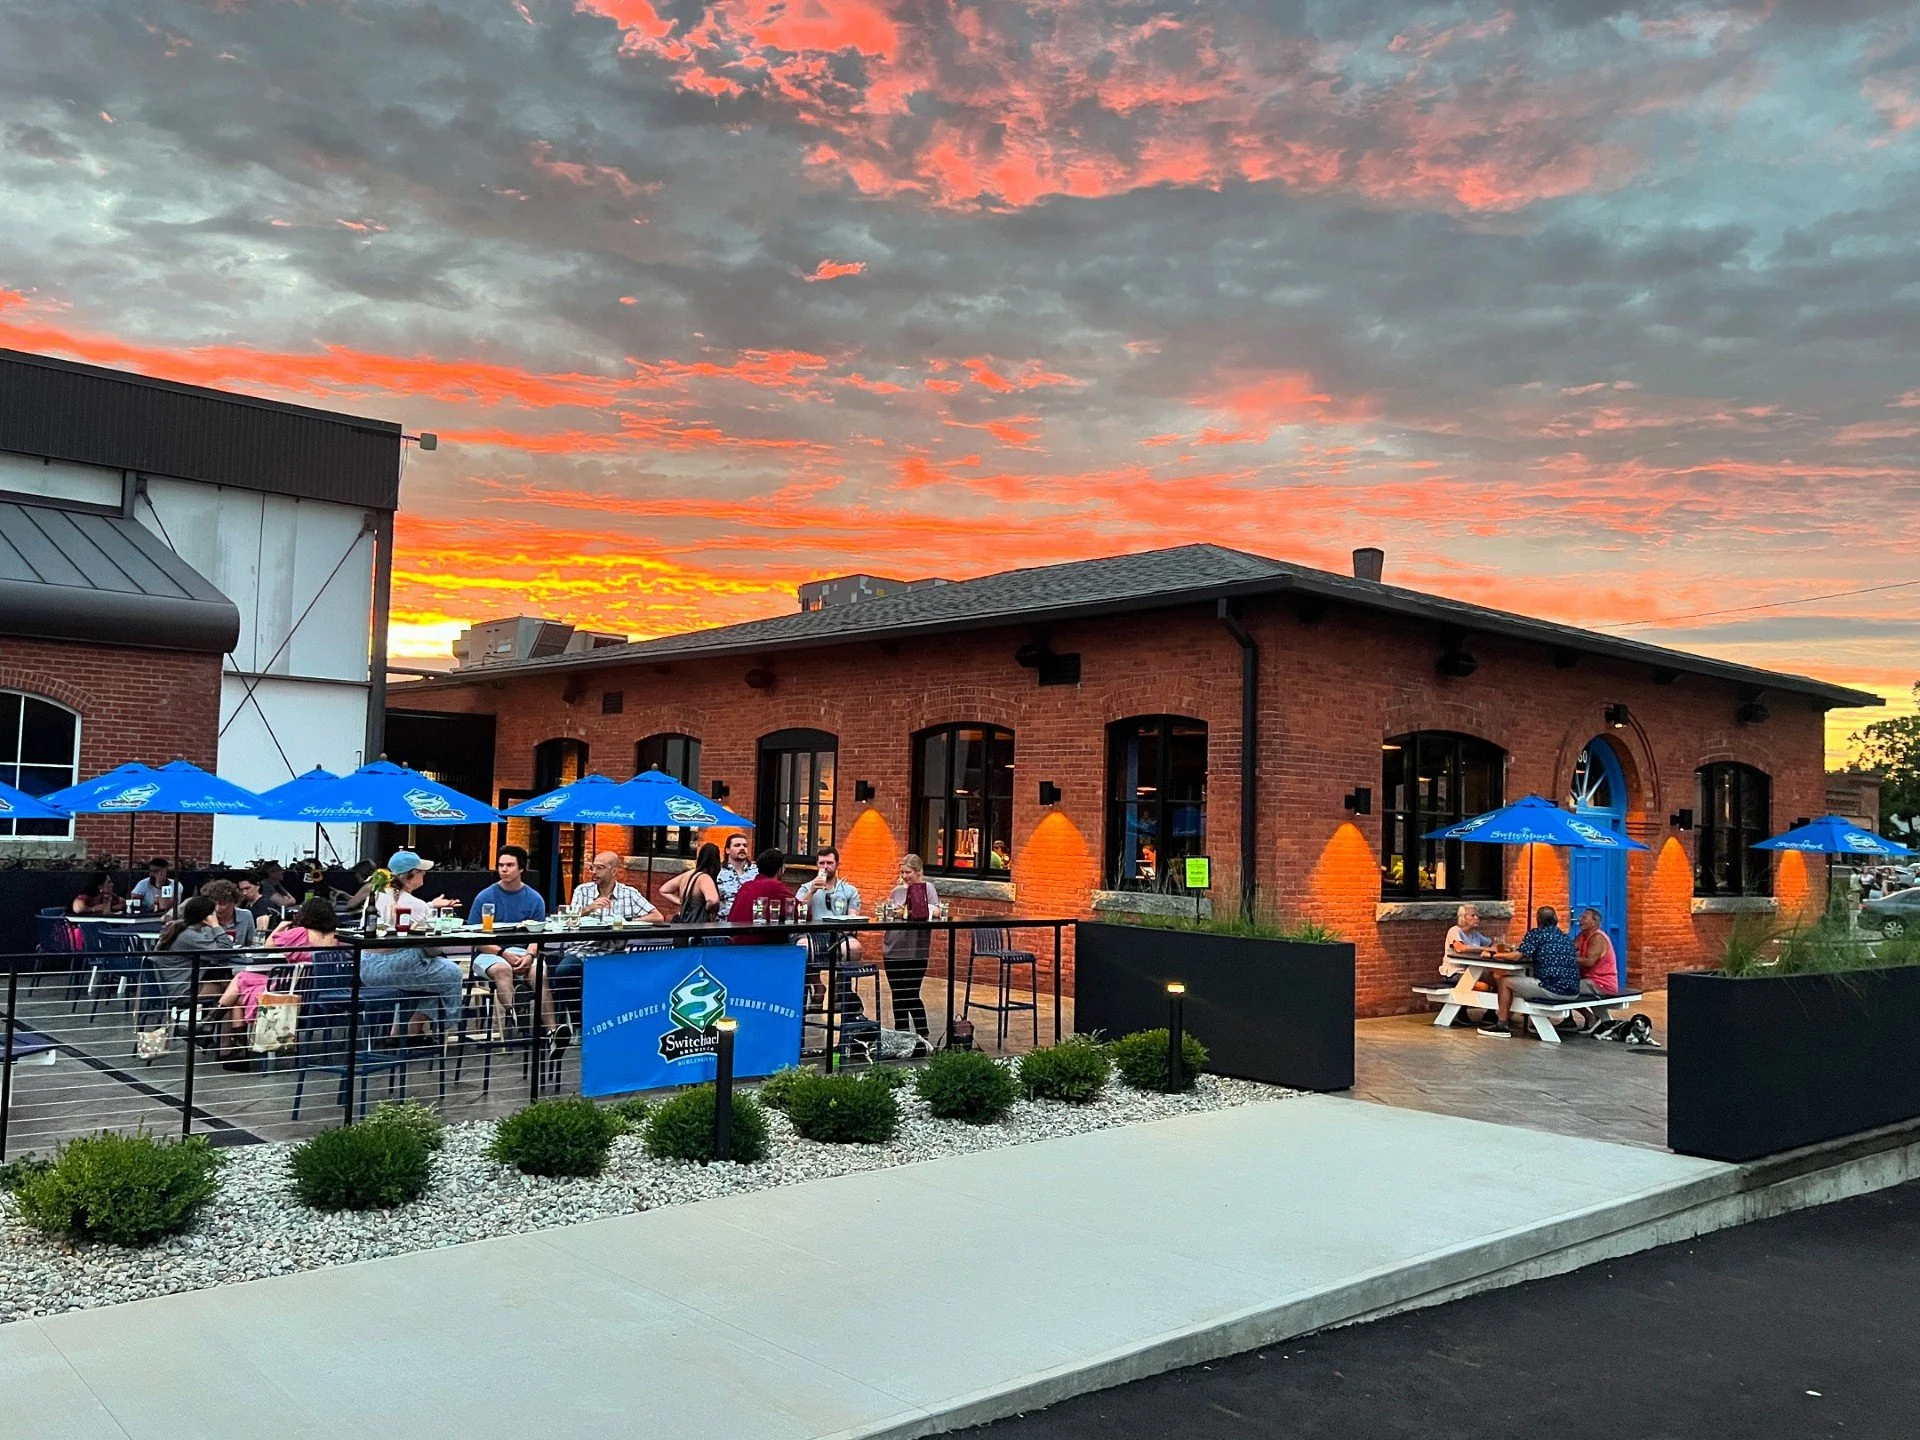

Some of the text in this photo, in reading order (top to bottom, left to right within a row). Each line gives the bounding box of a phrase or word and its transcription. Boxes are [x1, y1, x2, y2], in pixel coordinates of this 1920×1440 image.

[298, 806, 375, 817] Switchback
[575, 809, 636, 820] Switchback
[1489, 830, 1558, 841] Switchback
[591, 1019, 614, 1036] 100%
[616, 1004, 659, 1025] EMPLOYEE
[729, 997, 767, 1010] VERMONT
[768, 1003, 796, 1018] OWNED
